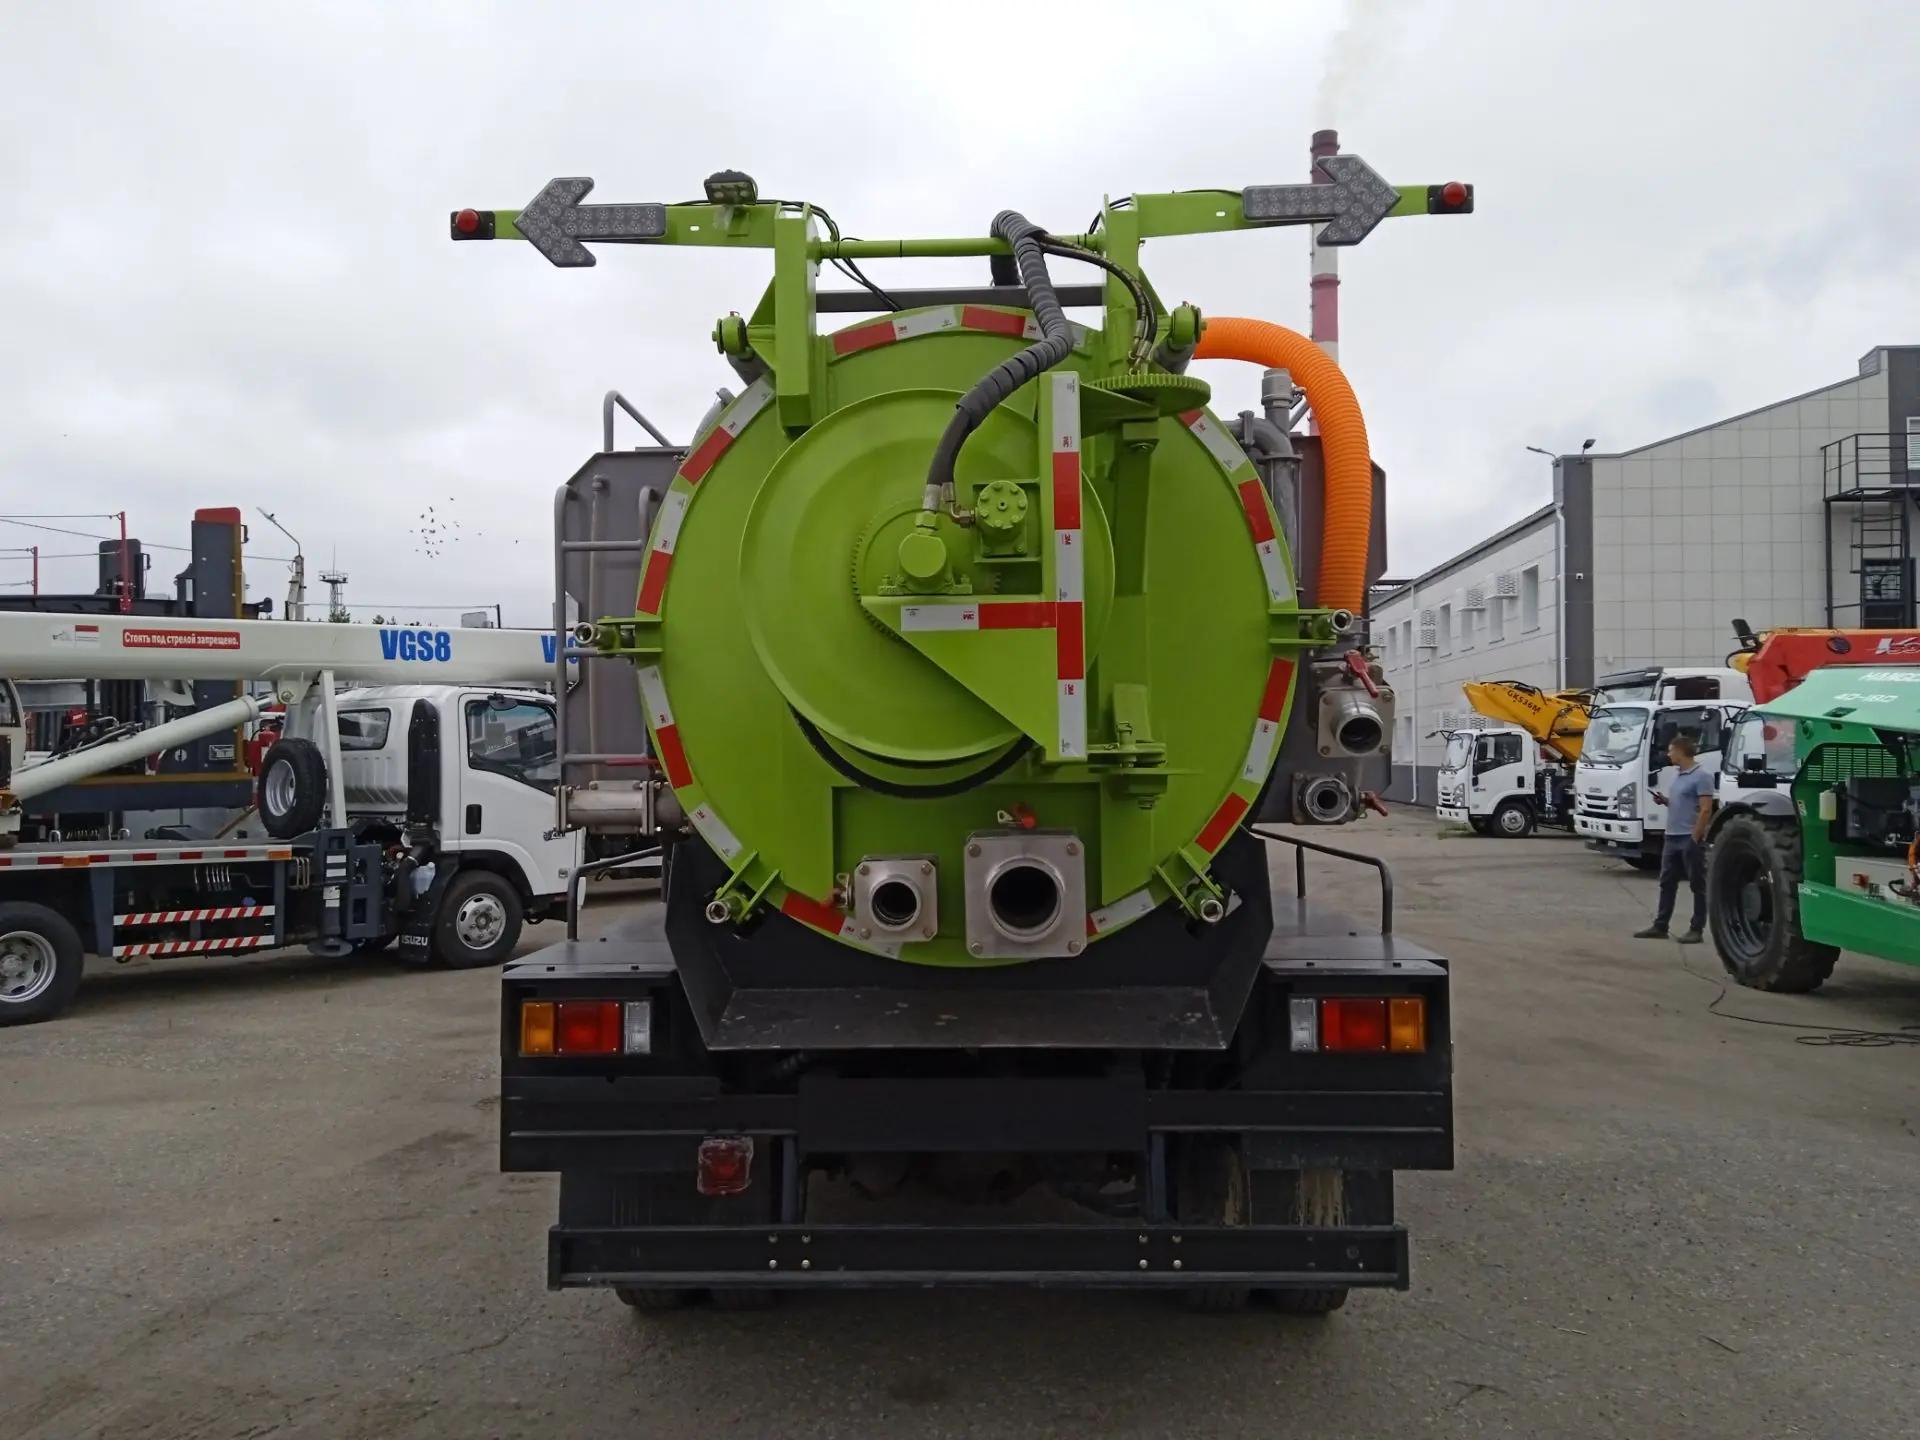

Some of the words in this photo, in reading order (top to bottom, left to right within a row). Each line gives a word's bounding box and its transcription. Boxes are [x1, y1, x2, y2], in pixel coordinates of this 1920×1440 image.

[124, 632, 151, 643] Стоять
[152, 634, 166, 645] под
[167, 633, 195, 647] стрелой
[379, 629, 451, 662] VGS8
